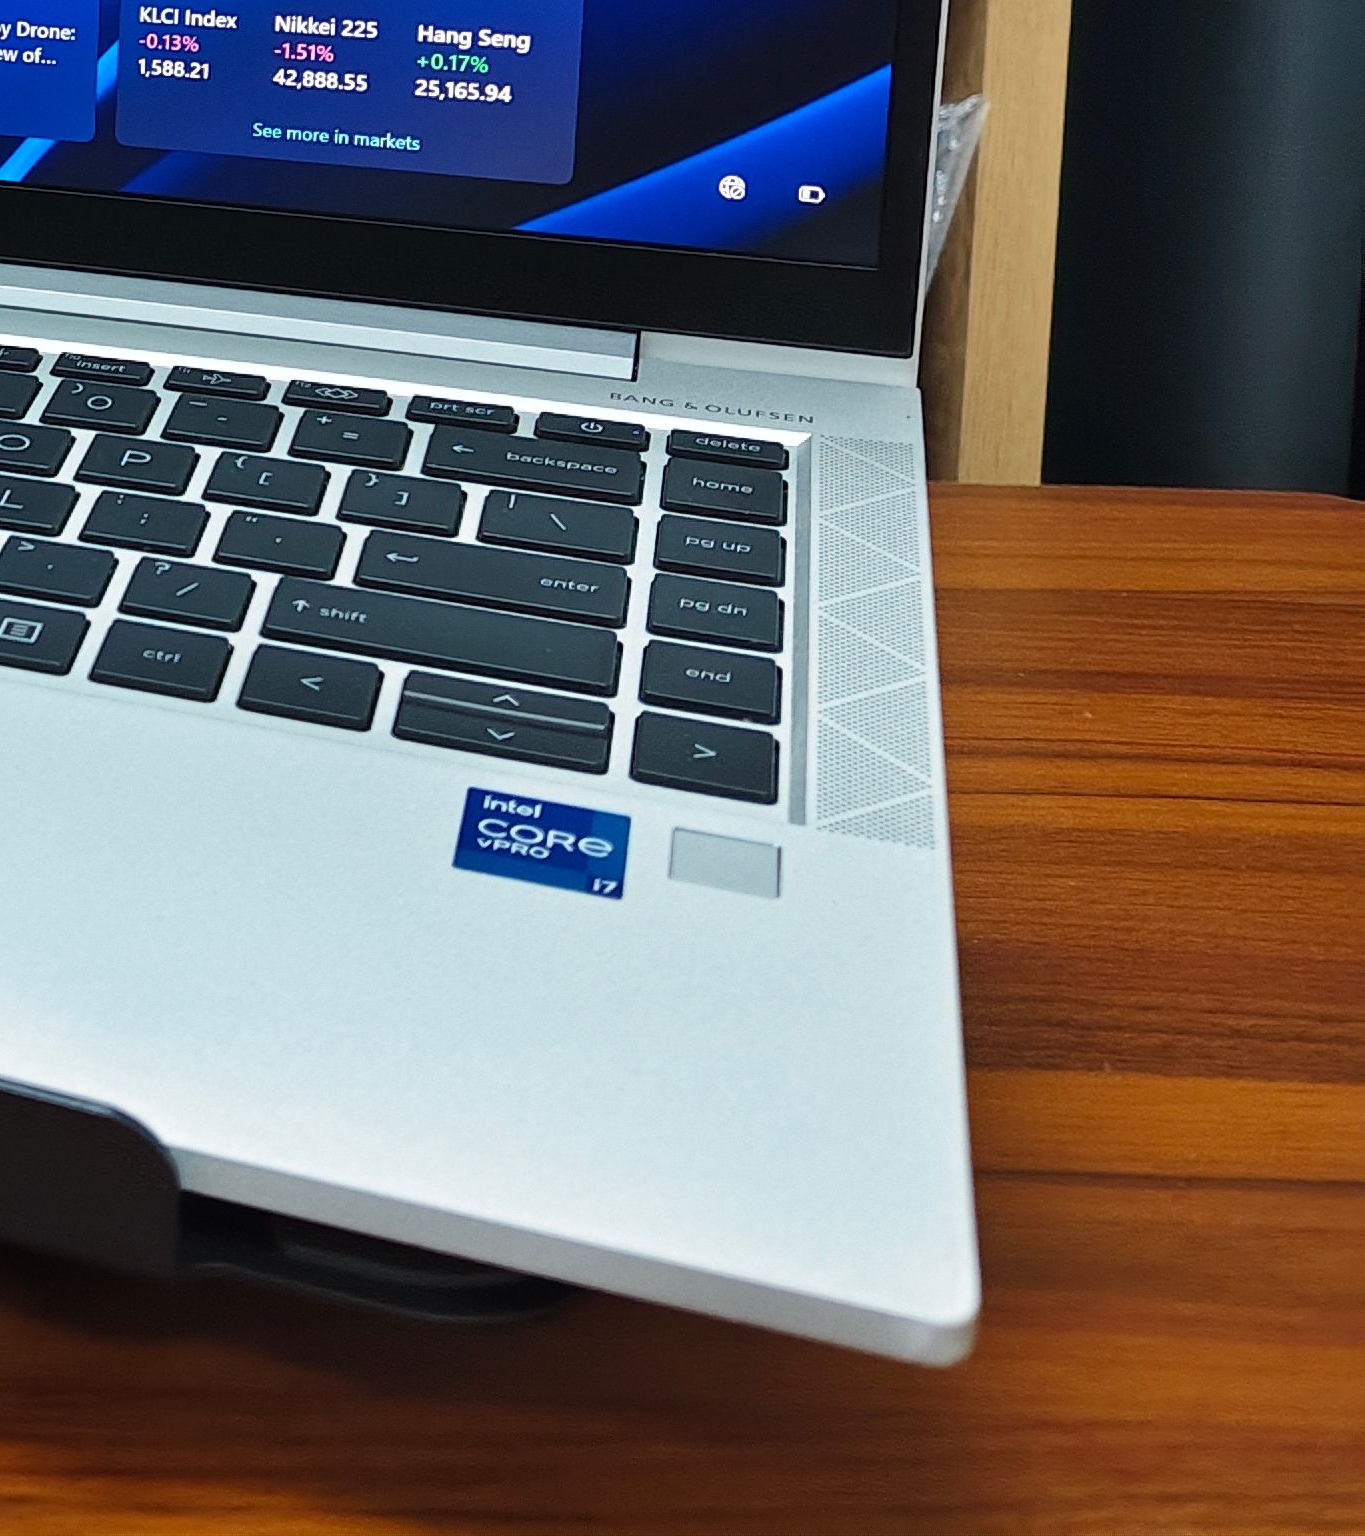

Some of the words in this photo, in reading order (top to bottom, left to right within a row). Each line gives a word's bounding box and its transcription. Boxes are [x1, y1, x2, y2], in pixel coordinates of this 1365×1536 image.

[138, 6, 180, 25] KLCI
[184, 10, 238, 29] Index
[274, 16, 336, 36] Nikkei
[341, 20, 378, 38] 225
[16, 22, 76, 41] Drone:
[417, 25, 472, 49] Hang
[478, 28, 532, 54] Seng
[138, 33, 200, 52] -0.13%
[22, 48, 56, 65] of...
[274, 43, 335, 62] -1.51%
[137, 58, 210, 80] 1,588.21
[416, 55, 490, 73] +0.17%
[272, 69, 368, 91] 42,888.55
[414, 79, 512, 103] 25,165.94
[253, 122, 282, 139] See
[286, 125, 329, 143] more
[334, 129, 350, 145] in
[353, 131, 421, 151] markets
[76, 359, 128, 373] insert
[429, 399, 461, 412] prt
[465, 406, 496, 416] scr
[610, 393, 674, 407] BANG
[683, 399, 699, 411] &
[705, 404, 814, 423] OLUFSEN
[696, 435, 763, 451] delete
[121, 450, 151, 466] P
[507, 452, 617, 473] backspace
[693, 478, 752, 493] home
[0, 490, 23, 509] L
[685, 536, 715, 549] pg
[722, 541, 751, 553] up
[541, 579, 598, 592] enter
[320, 608, 366, 622] shift
[680, 598, 709, 611] pg
[717, 603, 747, 617] dn
[142, 649, 182, 663] ctrl
[686, 669, 730, 682] end
[481, 794, 542, 819] intel
[591, 878, 618, 894] i7
